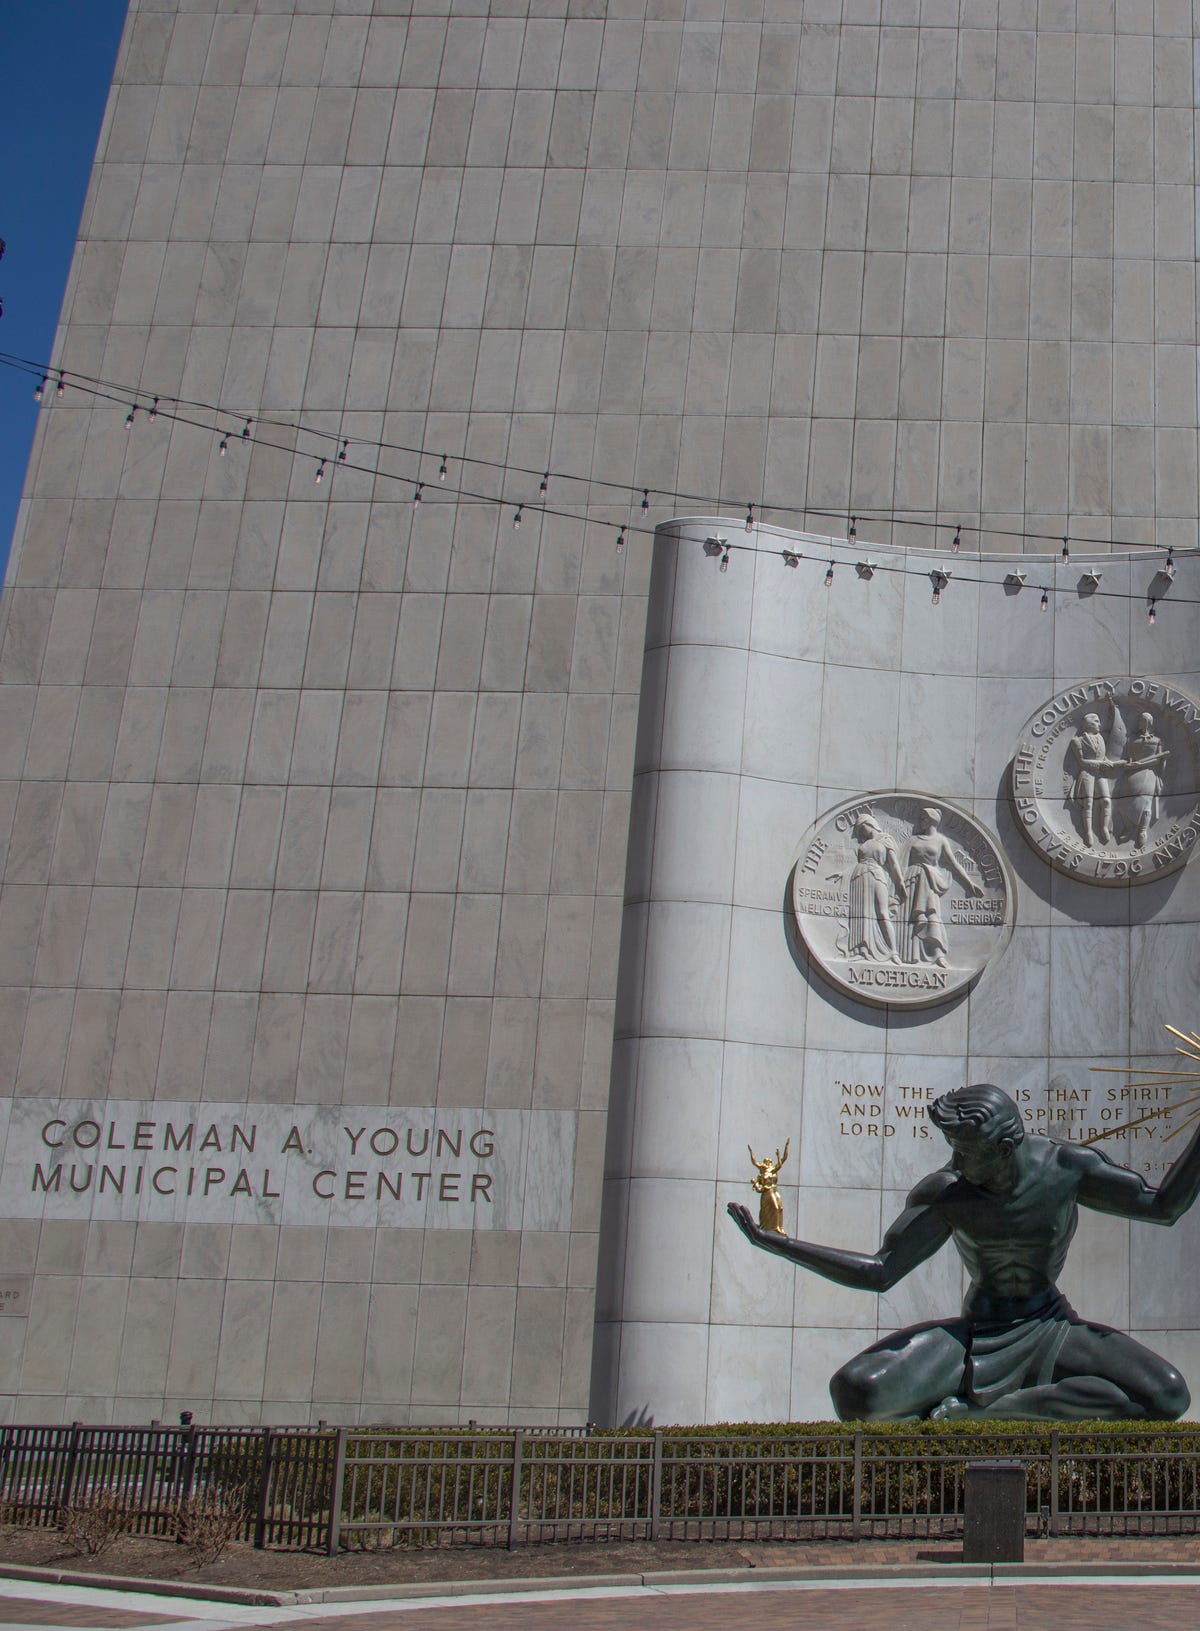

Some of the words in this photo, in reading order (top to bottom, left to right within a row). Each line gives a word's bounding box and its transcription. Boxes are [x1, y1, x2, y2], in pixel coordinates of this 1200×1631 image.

[1015, 742, 1036, 790] THE
[1031, 679, 1121, 739] COUNTY
[1129, 680, 1160, 697] OF
[1019, 797, 1038, 826] OF
[801, 837, 829, 875] THE
[1037, 826, 1083, 869] SEAL
[1094, 858, 1143, 878] 1796
[848, 967, 948, 990] MICHIGAN
[898, 1086, 935, 1100] THE
[1015, 1089, 1031, 1102] IS
[1044, 1088, 1092, 1102] THAT
[1107, 1087, 1173, 1101] SPIRIT
[840, 1103, 882, 1118] AND
[1024, 1107, 1088, 1121] SPIRIT
[1100, 1107, 1124, 1121] OF
[1137, 1106, 1173, 1120] THE
[42, 1119, 257, 1153] COLEMAN
[281, 1125, 313, 1154] A.
[344, 1127, 495, 1158] YOUNG
[840, 1122, 896, 1137] LORD
[31, 1163, 281, 1198] MUNICIPAL
[312, 1170, 493, 1202] CENTER
